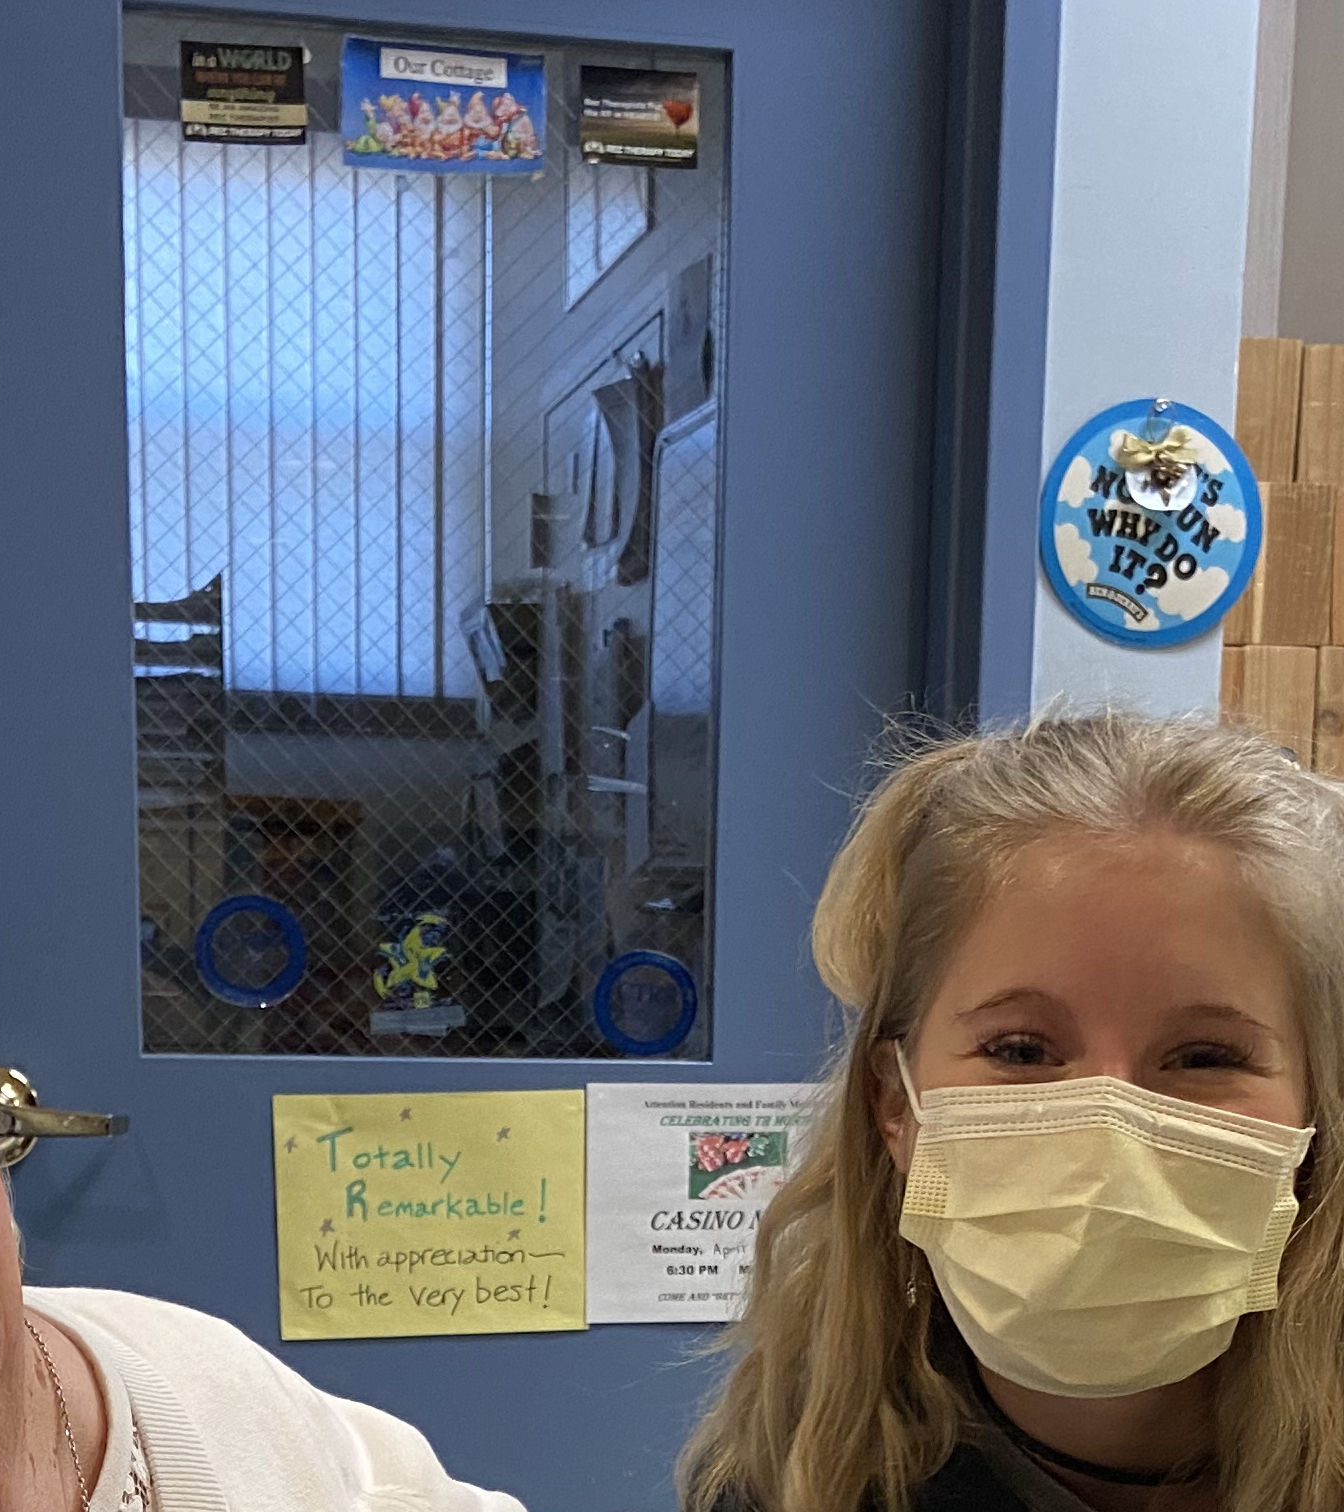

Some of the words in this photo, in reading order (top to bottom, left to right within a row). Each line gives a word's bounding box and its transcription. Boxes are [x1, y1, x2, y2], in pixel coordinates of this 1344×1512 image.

[218, 47, 292, 72] WORLD
[394, 55, 426, 74] Our
[431, 59, 494, 84] Cottage
[1090, 465, 1136, 505] NO
[1164, 503, 1220, 554] UN
[1088, 508, 1162, 547] WHY
[1154, 533, 1198, 581] DO
[1109, 544, 1168, 595] IT?
[689, 1100, 733, 1109] Residents
[735, 1100, 753, 1109] and
[755, 1100, 787, 1112] Family
[659, 1115, 751, 1127] CELEBRATING
[316, 1126, 461, 1185] Totally
[650, 1209, 744, 1231] CASINO
[314, 1239, 368, 1273] With
[652, 1244, 703, 1256] Monday,
[666, 1265, 694, 1276] 6:30
[698, 1265, 718, 1275] PM
[299, 1284, 335, 1310] To
[349, 1283, 393, 1307] the
[475, 1273, 552, 1310] best!
[687, 1293, 711, 1302] AND
